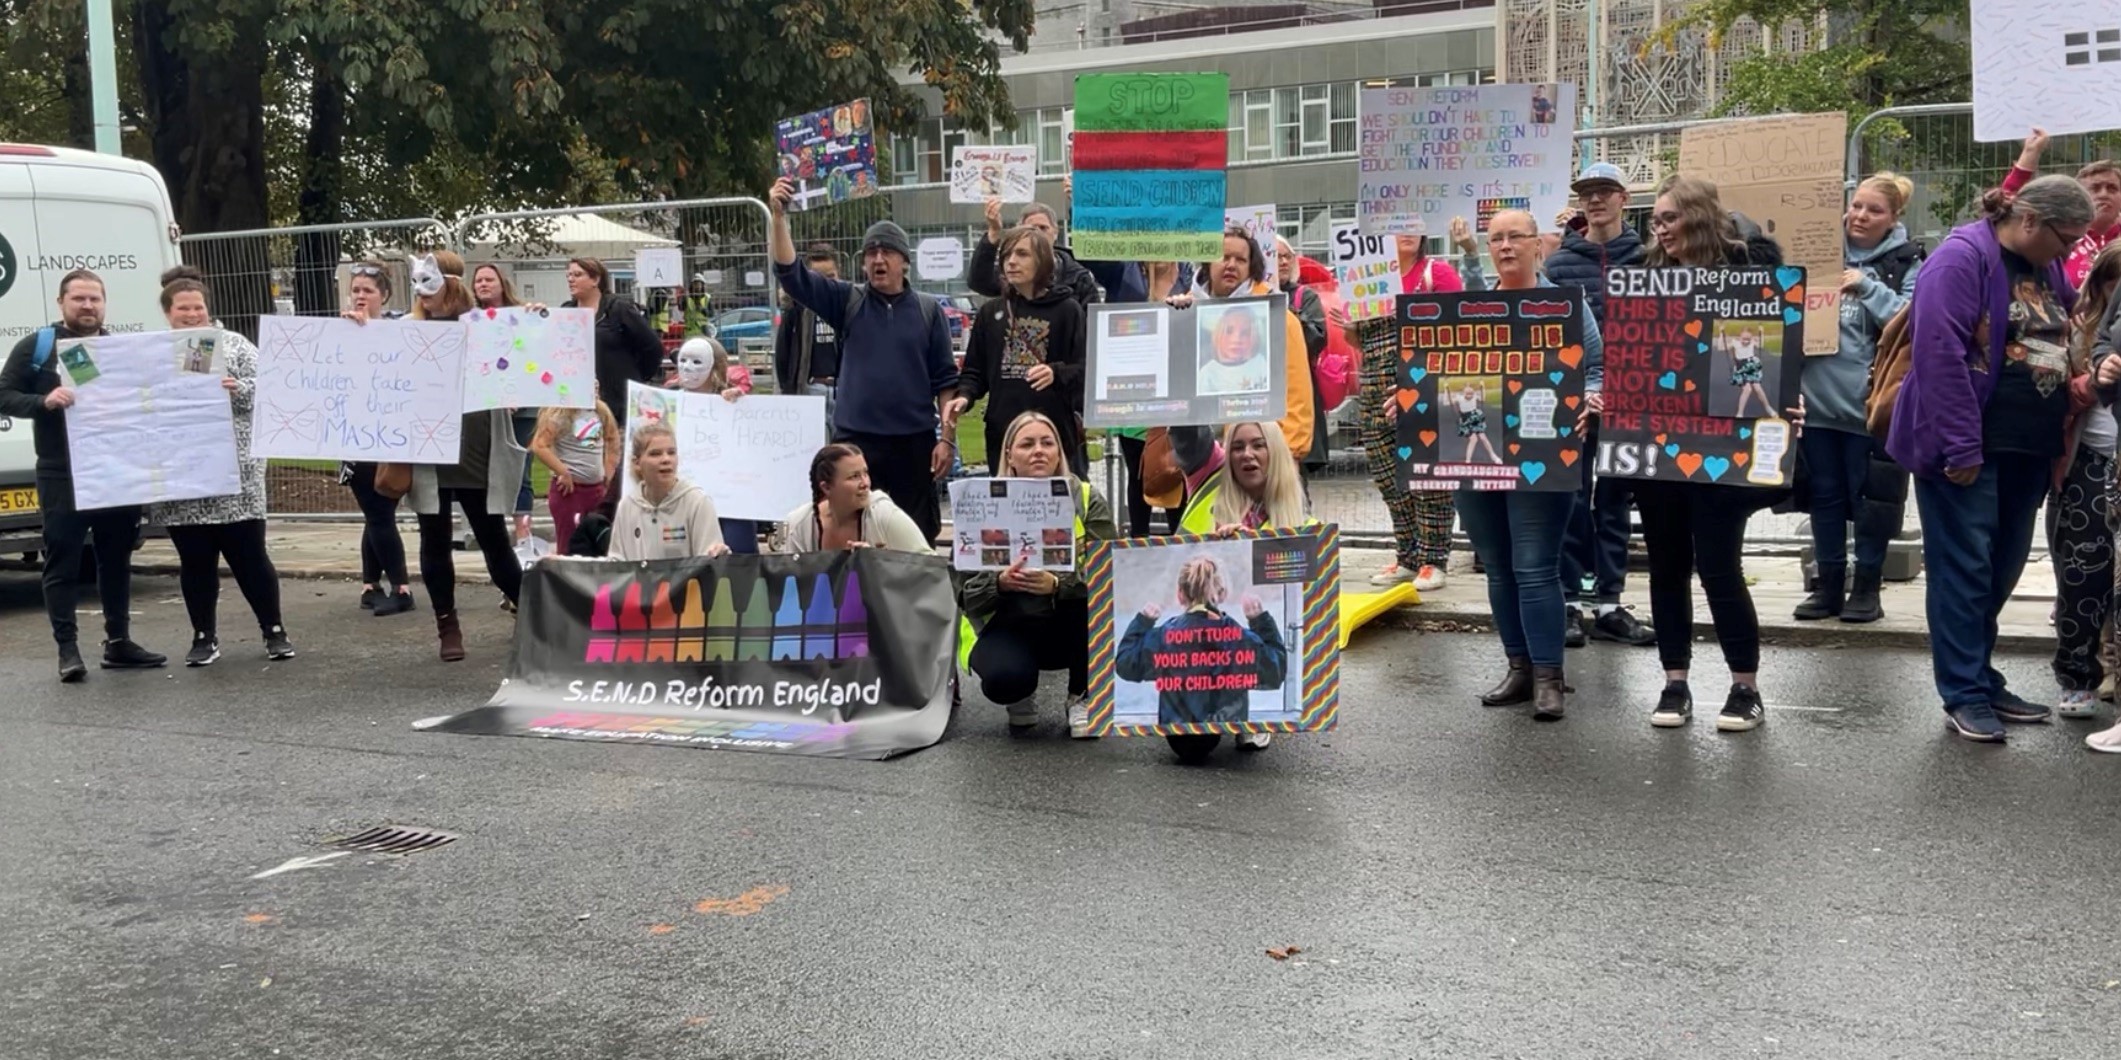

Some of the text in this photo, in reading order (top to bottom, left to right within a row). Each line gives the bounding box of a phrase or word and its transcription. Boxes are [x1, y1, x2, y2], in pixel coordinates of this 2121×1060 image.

[1108, 78, 1195, 115] STOP
[1362, 113, 1383, 128] WE
[1388, 106, 1458, 126] SHOULDN'T
[1501, 110, 1516, 124] TO
[1362, 124, 1550, 143] FIGHT FOR OUR CHILDREN TO
[1362, 140, 1511, 158] GET THE FUNDING AND
[1707, 127, 1834, 168] EDUCATE
[1361, 156, 1428, 172] EDUCATION
[1434, 155, 1466, 170] THEY
[1081, 179, 1144, 207] SEND
[1361, 182, 1376, 199] I'M
[1379, 182, 1410, 199] ONLY
[1416, 182, 1449, 197] HERE
[1457, 183, 1474, 197] AS
[1482, 178, 1505, 197] IT'S
[1540, 181, 1553, 196] IN
[1363, 200, 1396, 214] THING
[1424, 199, 1442, 213] DO
[27, 254, 138, 271] LANDSCAPES
[1337, 260, 1399, 283] FAILING
[1353, 281, 1389, 298] OUR
[1607, 267, 1771, 296] SEND Reform
[1606, 300, 1686, 320] THIS IS
[1694, 294, 1781, 318] England
[1403, 325, 1563, 348] ENOUGH IS
[1604, 321, 1684, 343] DOLLY.
[312, 342, 402, 364] Let our
[1427, 352, 1544, 374] ENOUGH
[1605, 346, 1685, 371] SHE IS
[285, 368, 417, 392] Children take
[1604, 371, 1659, 392] NOT
[367, 393, 412, 415] their
[681, 397, 801, 432] Let parents
[1604, 393, 1702, 415] BROKEN!
[324, 418, 408, 450] MASKS
[1603, 412, 1734, 436] THE SYSTEM
[694, 424, 804, 448] be HEARD!
[1413, 463, 1521, 477] MY GRANDDAUGHTER
[1409, 480, 1516, 490] DESERVES BETTER!
[1165, 626, 1243, 644] DON'T TURN
[1154, 650, 1256, 668] YOUR BACKS ON
[1156, 673, 1258, 691] OUR CHILDREN!
[563, 676, 881, 715] S.E.N.D Reform England
